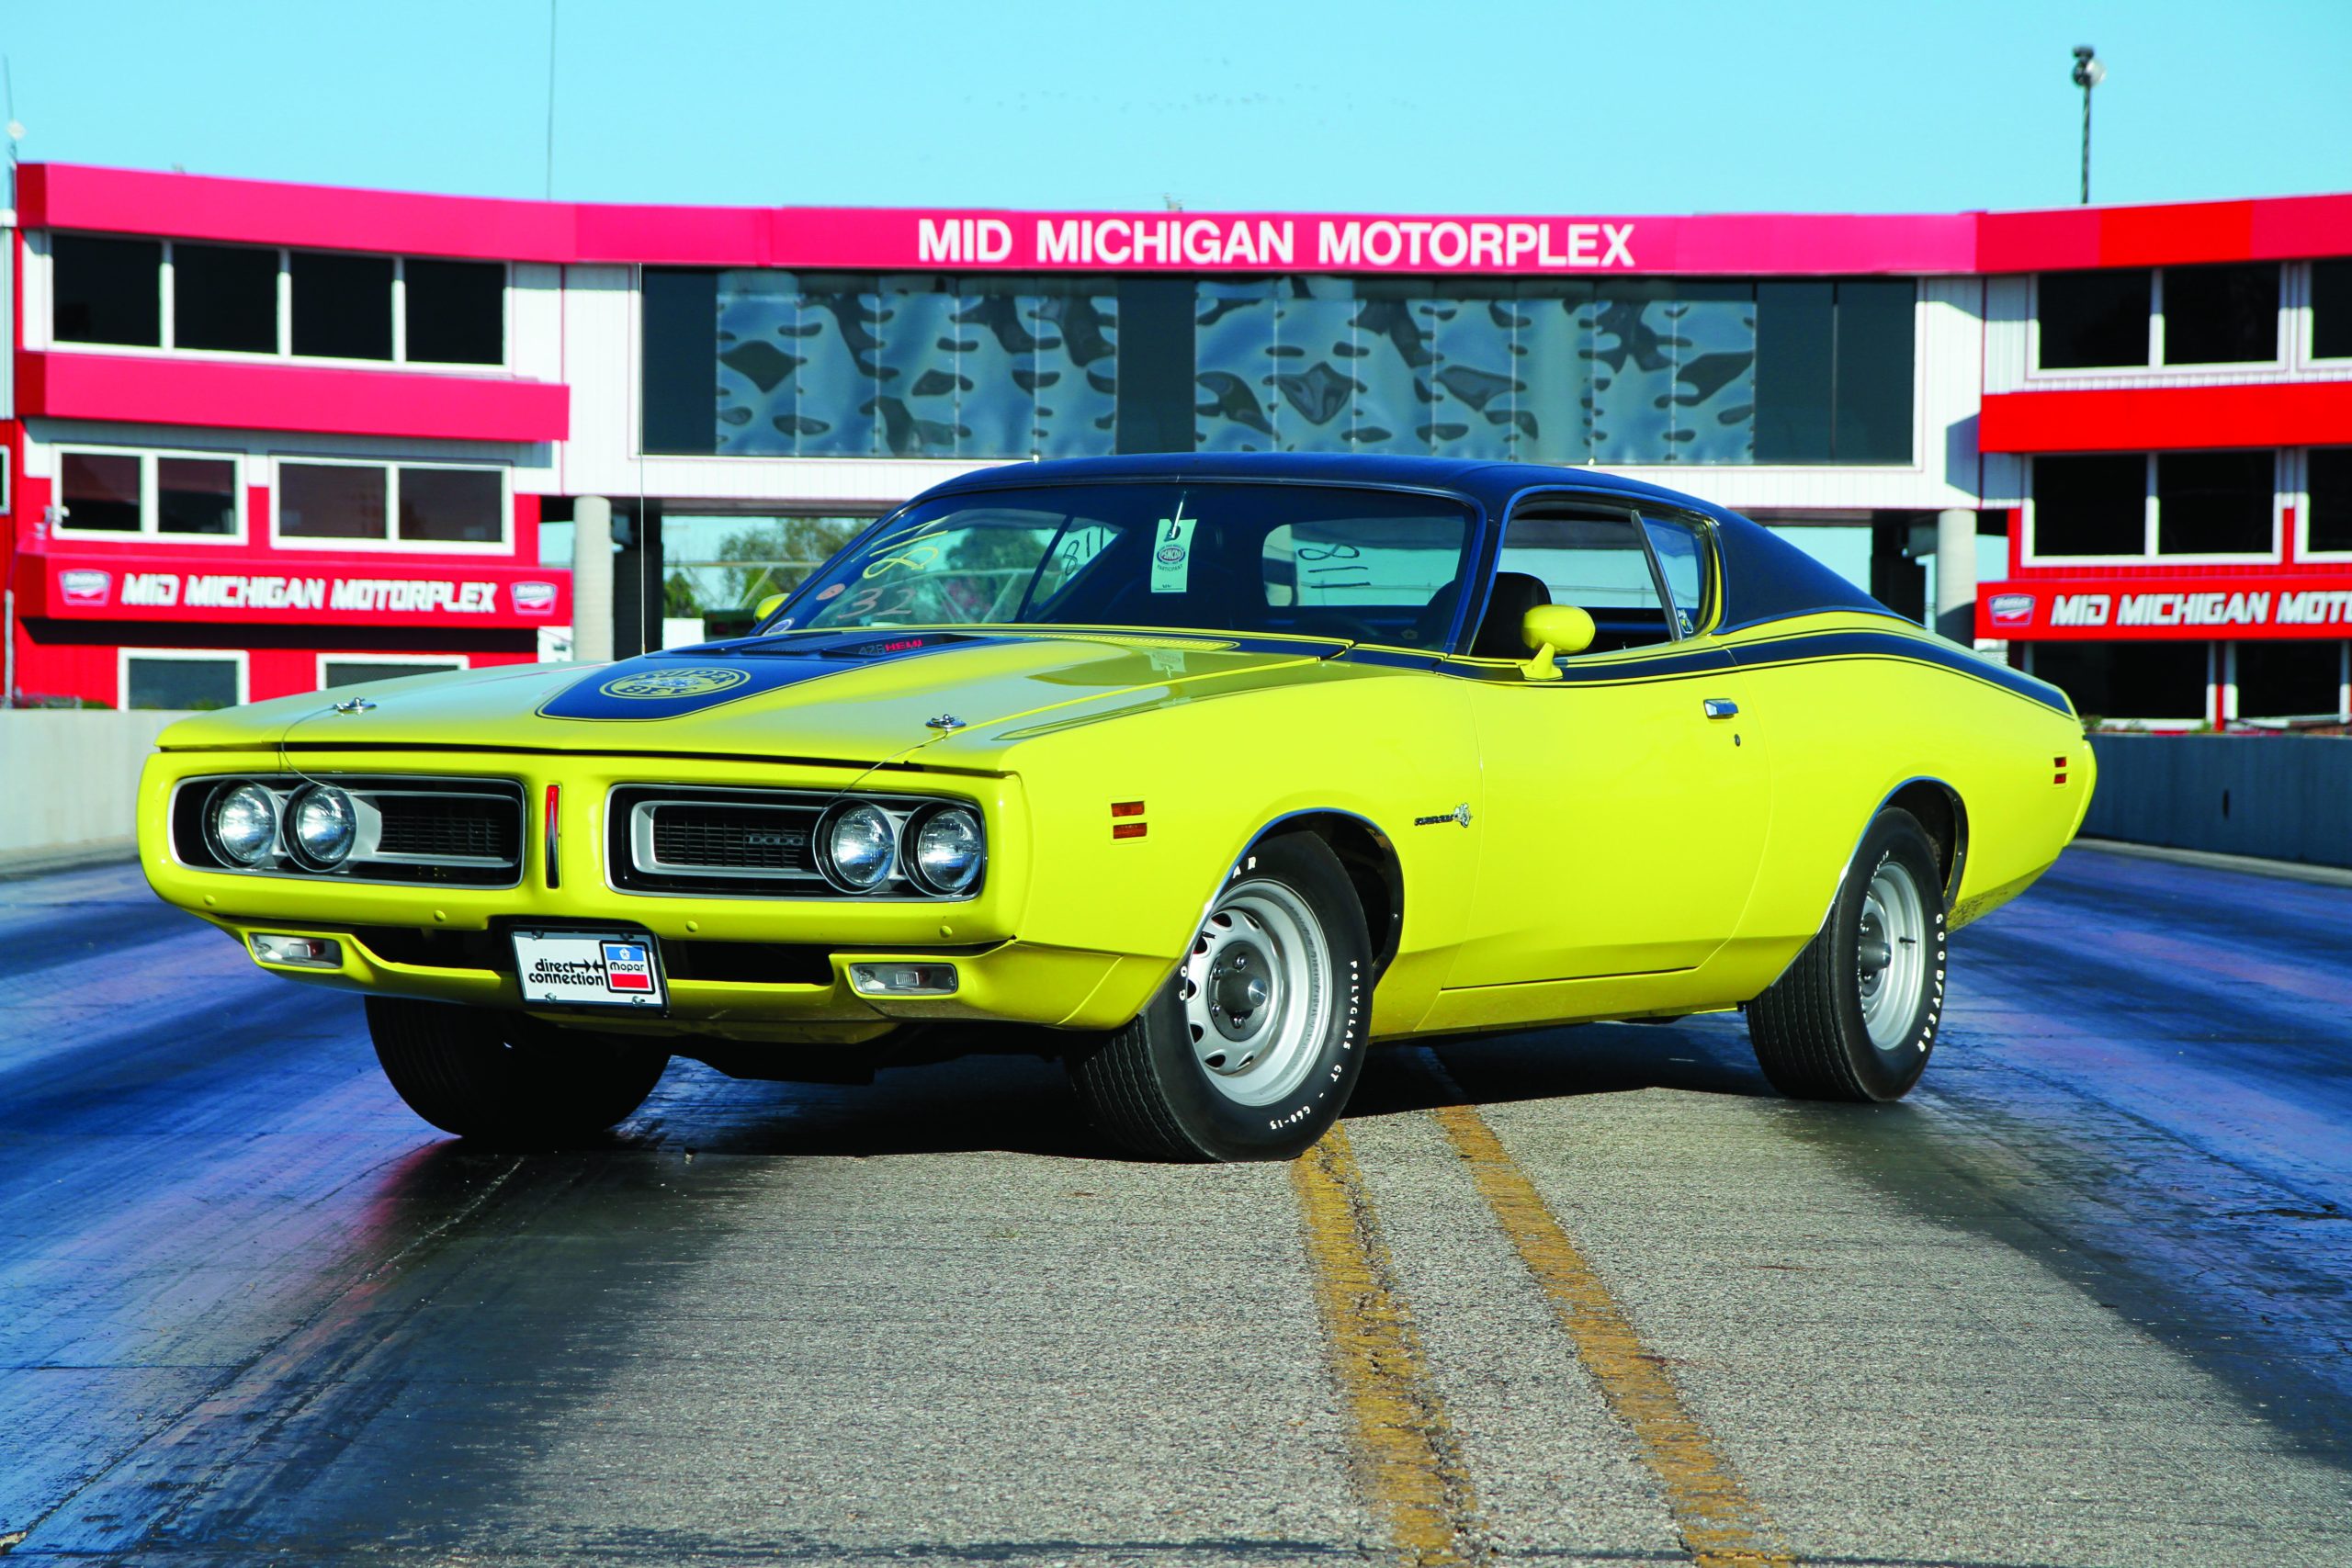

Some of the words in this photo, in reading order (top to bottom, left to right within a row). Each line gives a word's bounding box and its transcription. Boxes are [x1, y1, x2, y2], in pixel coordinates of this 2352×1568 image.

[919, 220, 1012, 262] MID
[1035, 220, 1294, 264] MICHIGAN
[1318, 221, 1634, 266] MOTORPLEX
[121, 573, 180, 606] MID
[185, 576, 326, 610] MICHIGAN
[330, 580, 497, 614] MOTORPLEX
[837, 588, 916, 619] 32
[2050, 594, 2111, 626] MID
[2116, 592, 2271, 626] MICHIGAN
[885, 638, 923, 652] HEMI
[528, 972, 605, 987] connection
[535, 958, 575, 974] direct
[1918, 913, 1946, 1053] GOODYEAR
[1342, 960, 1359, 1050] POLYGLAS
[1330, 1064, 1342, 1082] GT
[1270, 1105, 1311, 1130] G60-15
